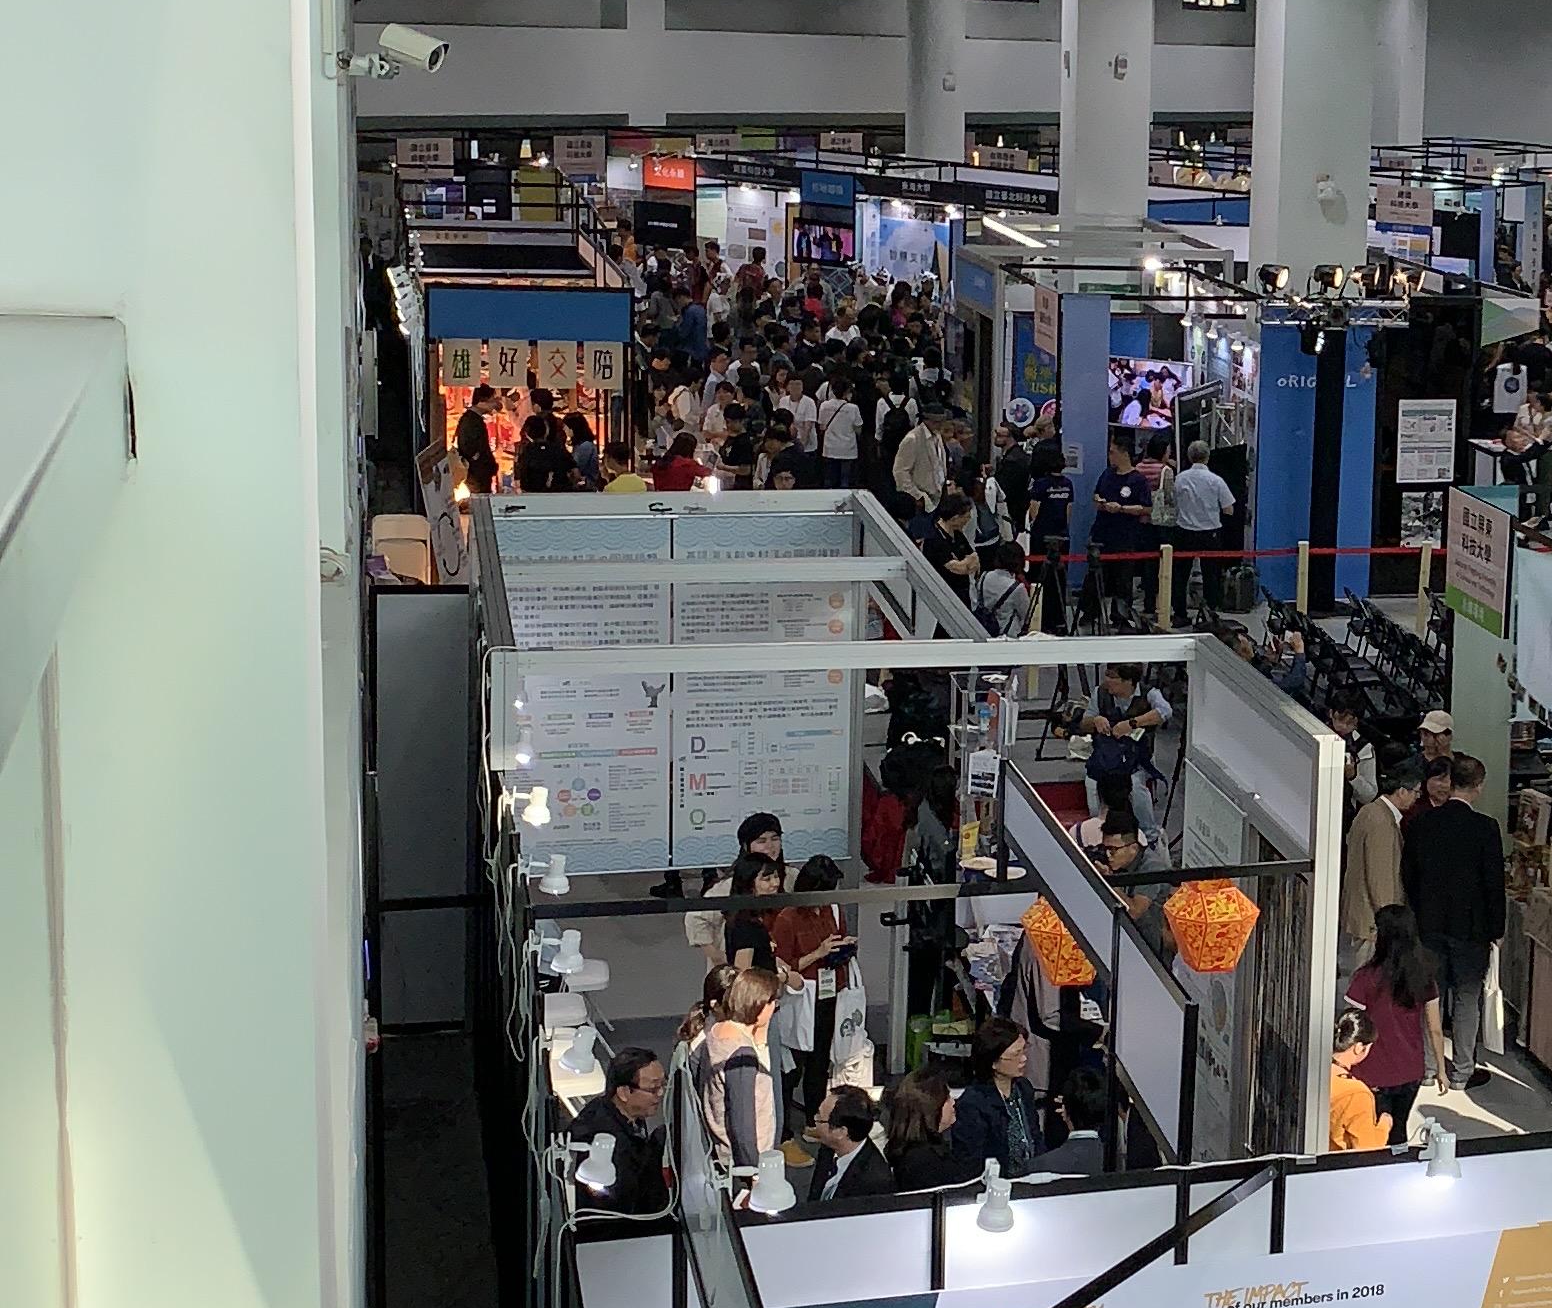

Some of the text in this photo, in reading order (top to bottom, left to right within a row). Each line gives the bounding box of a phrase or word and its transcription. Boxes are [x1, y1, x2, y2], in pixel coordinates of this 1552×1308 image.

[452, 346, 614, 380] 雄好交陪
[1243, 1281, 1310, 1302] IMPACT
[1336, 1288, 1349, 1301] in
[1351, 1284, 1385, 1299] 2018
